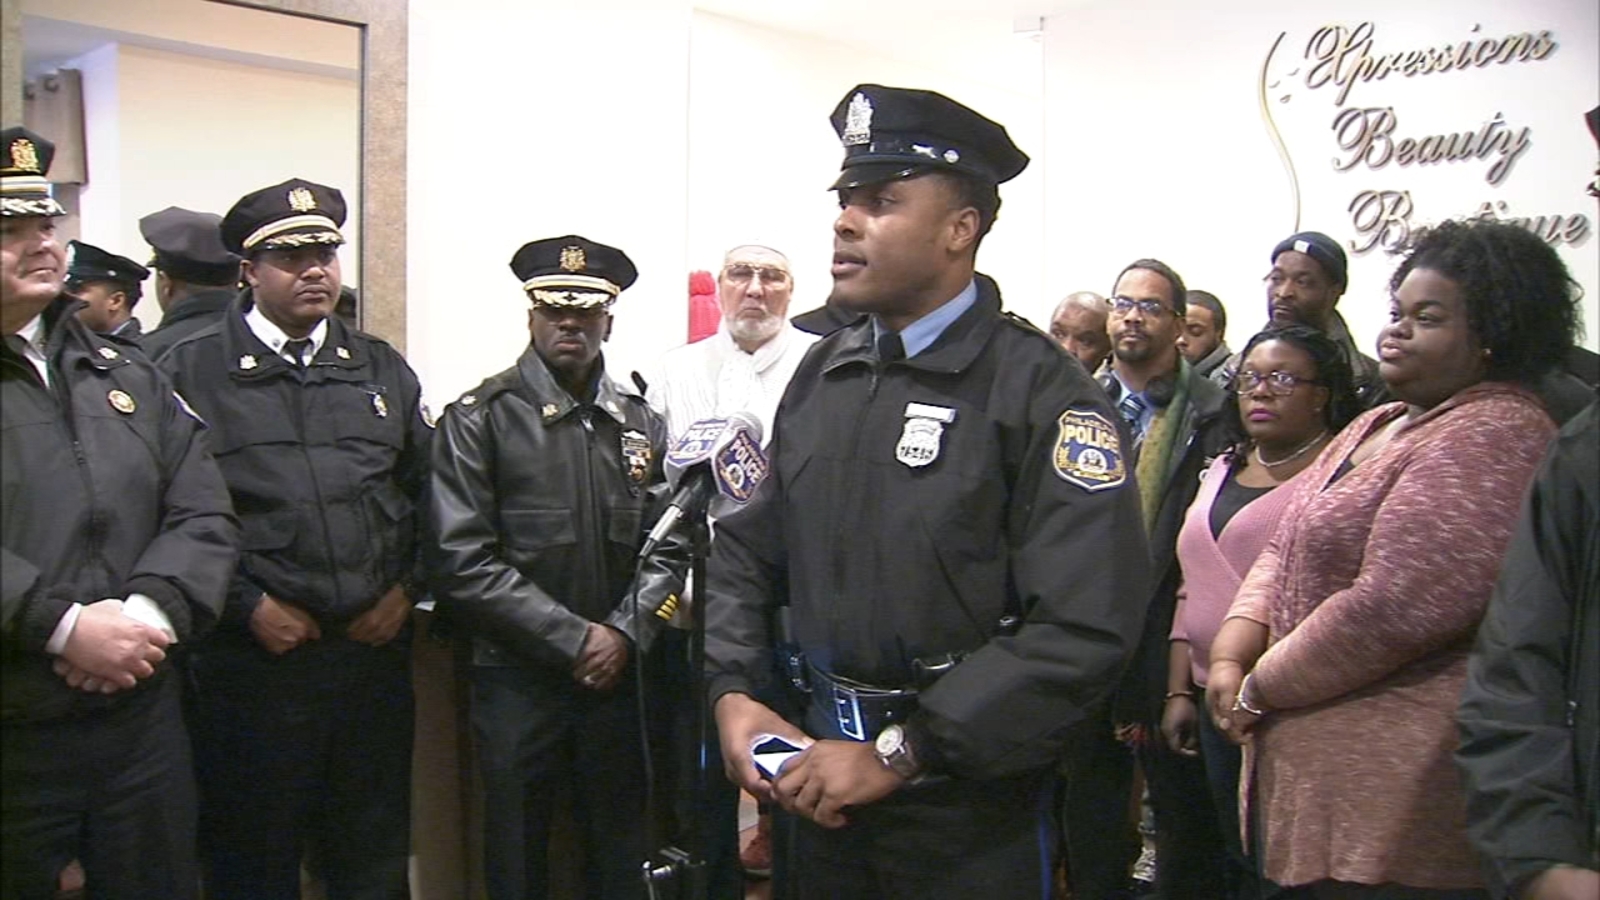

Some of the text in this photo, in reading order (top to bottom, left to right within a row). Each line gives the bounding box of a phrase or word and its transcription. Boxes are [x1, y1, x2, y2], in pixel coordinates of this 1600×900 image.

[1304, 22, 1558, 106] Xpressions
[1331, 106, 1530, 185] Beauty
[1347, 190, 1589, 256] Btue
[682, 429, 721, 441] POLICE
[729, 438, 763, 484] POLICE
[1064, 424, 1120, 454] POLICE
